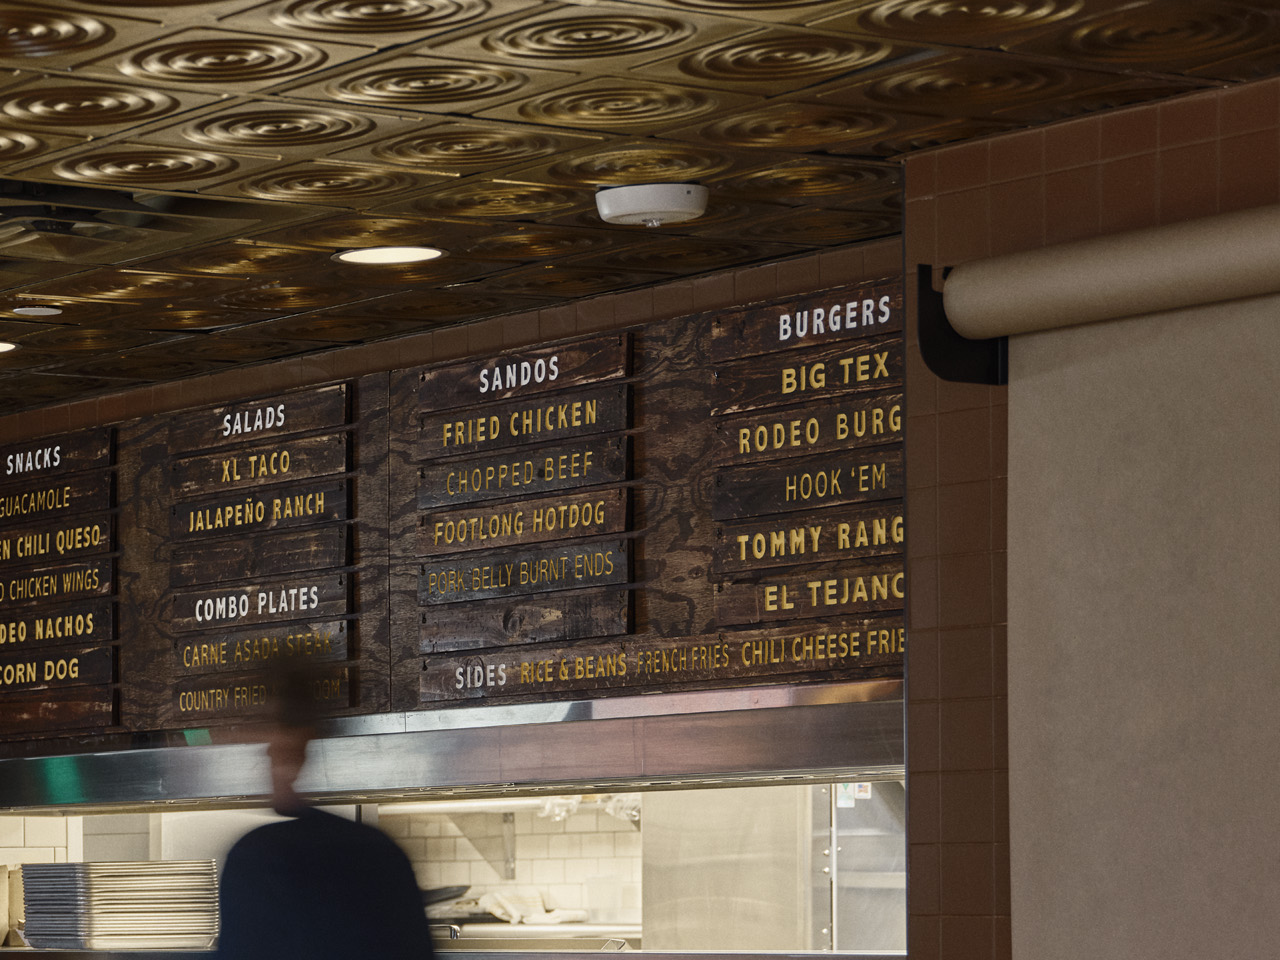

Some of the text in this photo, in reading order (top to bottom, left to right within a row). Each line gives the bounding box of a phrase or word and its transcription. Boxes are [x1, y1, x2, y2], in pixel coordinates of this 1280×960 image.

[779, 295, 891, 341] BURGERS
[479, 355, 559, 393] SANDOS
[781, 352, 889, 394] BIG TEX
[222, 404, 285, 437] SALADS
[442, 399, 597, 447] FRIED CHICKEN
[738, 405, 902, 454] RODEO BURG
[6, 446, 61, 475] SNACKS
[221, 450, 290, 483] XL TACO
[447, 451, 593, 496] CHOPPED BEEF
[786, 470, 842, 501] HOOK
[189, 492, 325, 532] JALAPEÑO RANCH
[434, 500, 605, 546] FOOTLONG HOTDOG
[17, 533, 50, 558] CHILI
[56, 525, 101, 551] QUESO
[737, 516, 904, 561] TOMMY RANG
[9, 573, 58, 602] CHICKEN
[62, 569, 99, 592] WINGS
[429, 551, 614, 595] PORK BELLY BURNT ENDS
[195, 586, 319, 622] COMBO PLATES
[764, 585, 794, 612] EL
[35, 613, 94, 641] NACHOS
[183, 631, 332, 667] CARNE ASADA STEAK
[455, 664, 507, 690] SIDES
[520, 659, 554, 685] RICE
[559, 657, 570, 681] &
[575, 653, 627, 680] BEANS
[637, 648, 687, 675] FRENCH
[692, 644, 730, 672] FRIES
[741, 638, 786, 666] CHILI
[792, 631, 860, 662] CHEESE
[44, 658, 79, 681] DOG
[179, 688, 230, 712] COUNTRY
[234, 684, 267, 709] FRIED
